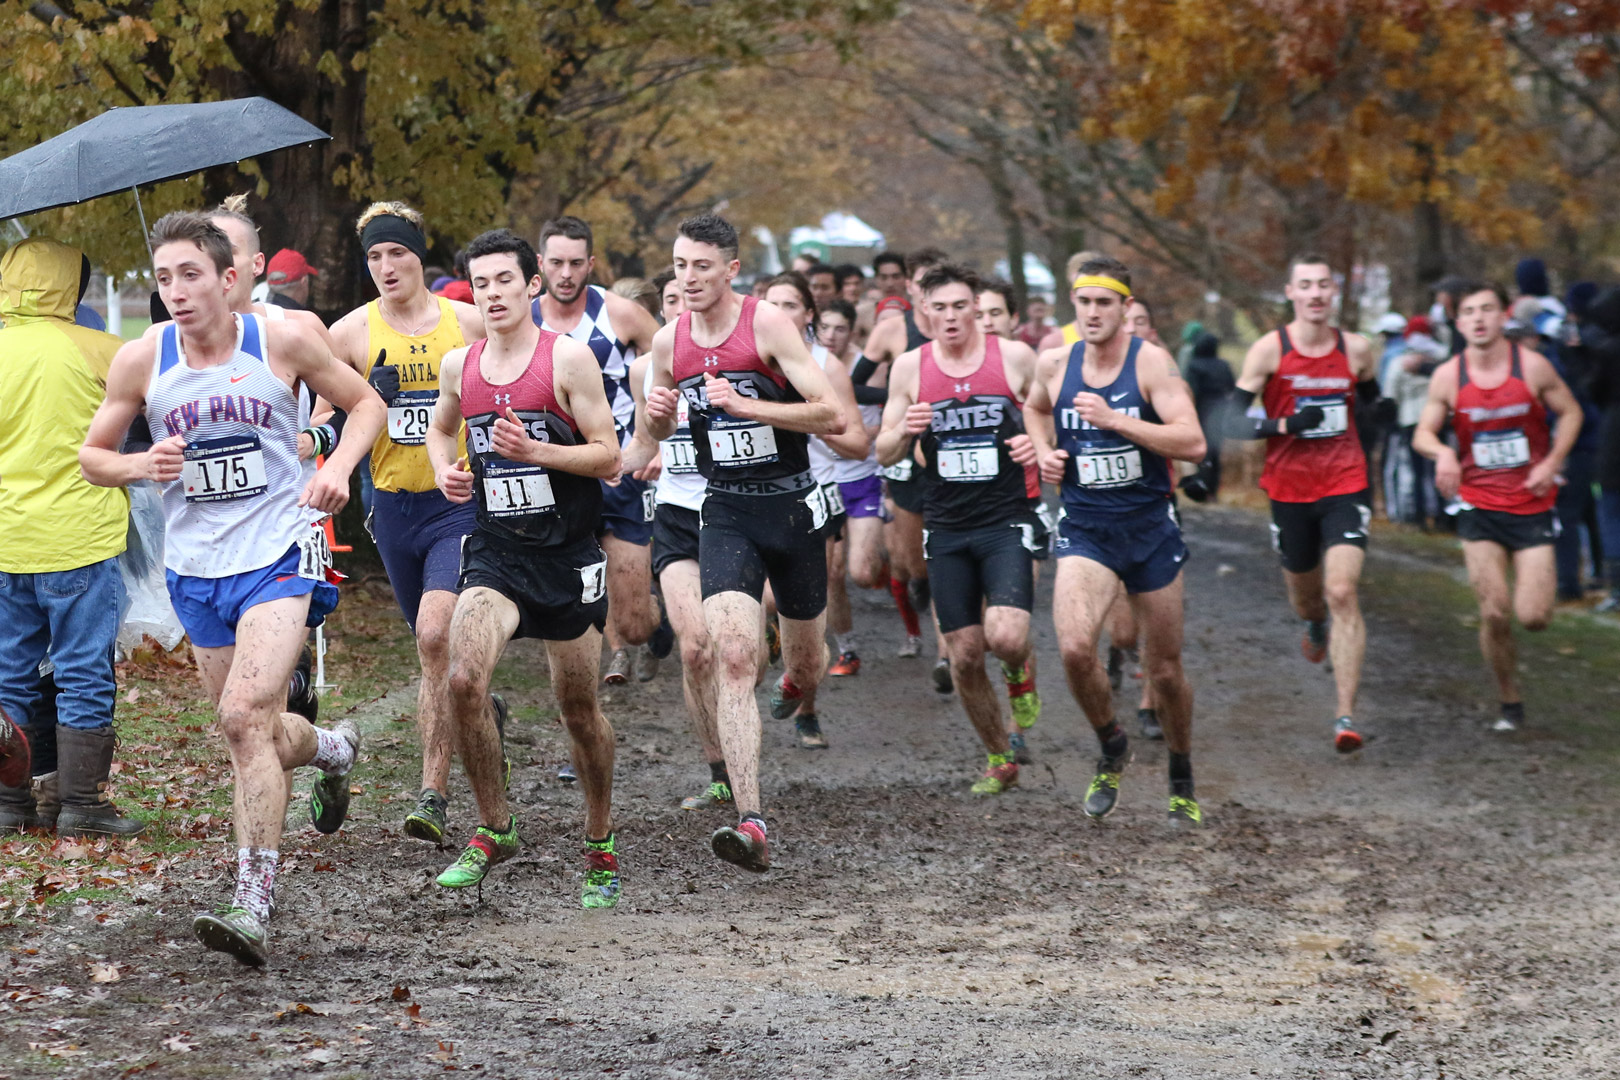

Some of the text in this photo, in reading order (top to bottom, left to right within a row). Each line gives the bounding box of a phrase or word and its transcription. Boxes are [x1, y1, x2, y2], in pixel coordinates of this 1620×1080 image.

[393, 362, 434, 383] ANTA
[208, 394, 273, 430] PALTZ
[931, 403, 1004, 433] BATES
[727, 430, 755, 458] 13
[197, 456, 249, 493] 175
[957, 451, 979, 475] 15
[1091, 455, 1129, 482] 119
[502, 478, 532, 508] 11
